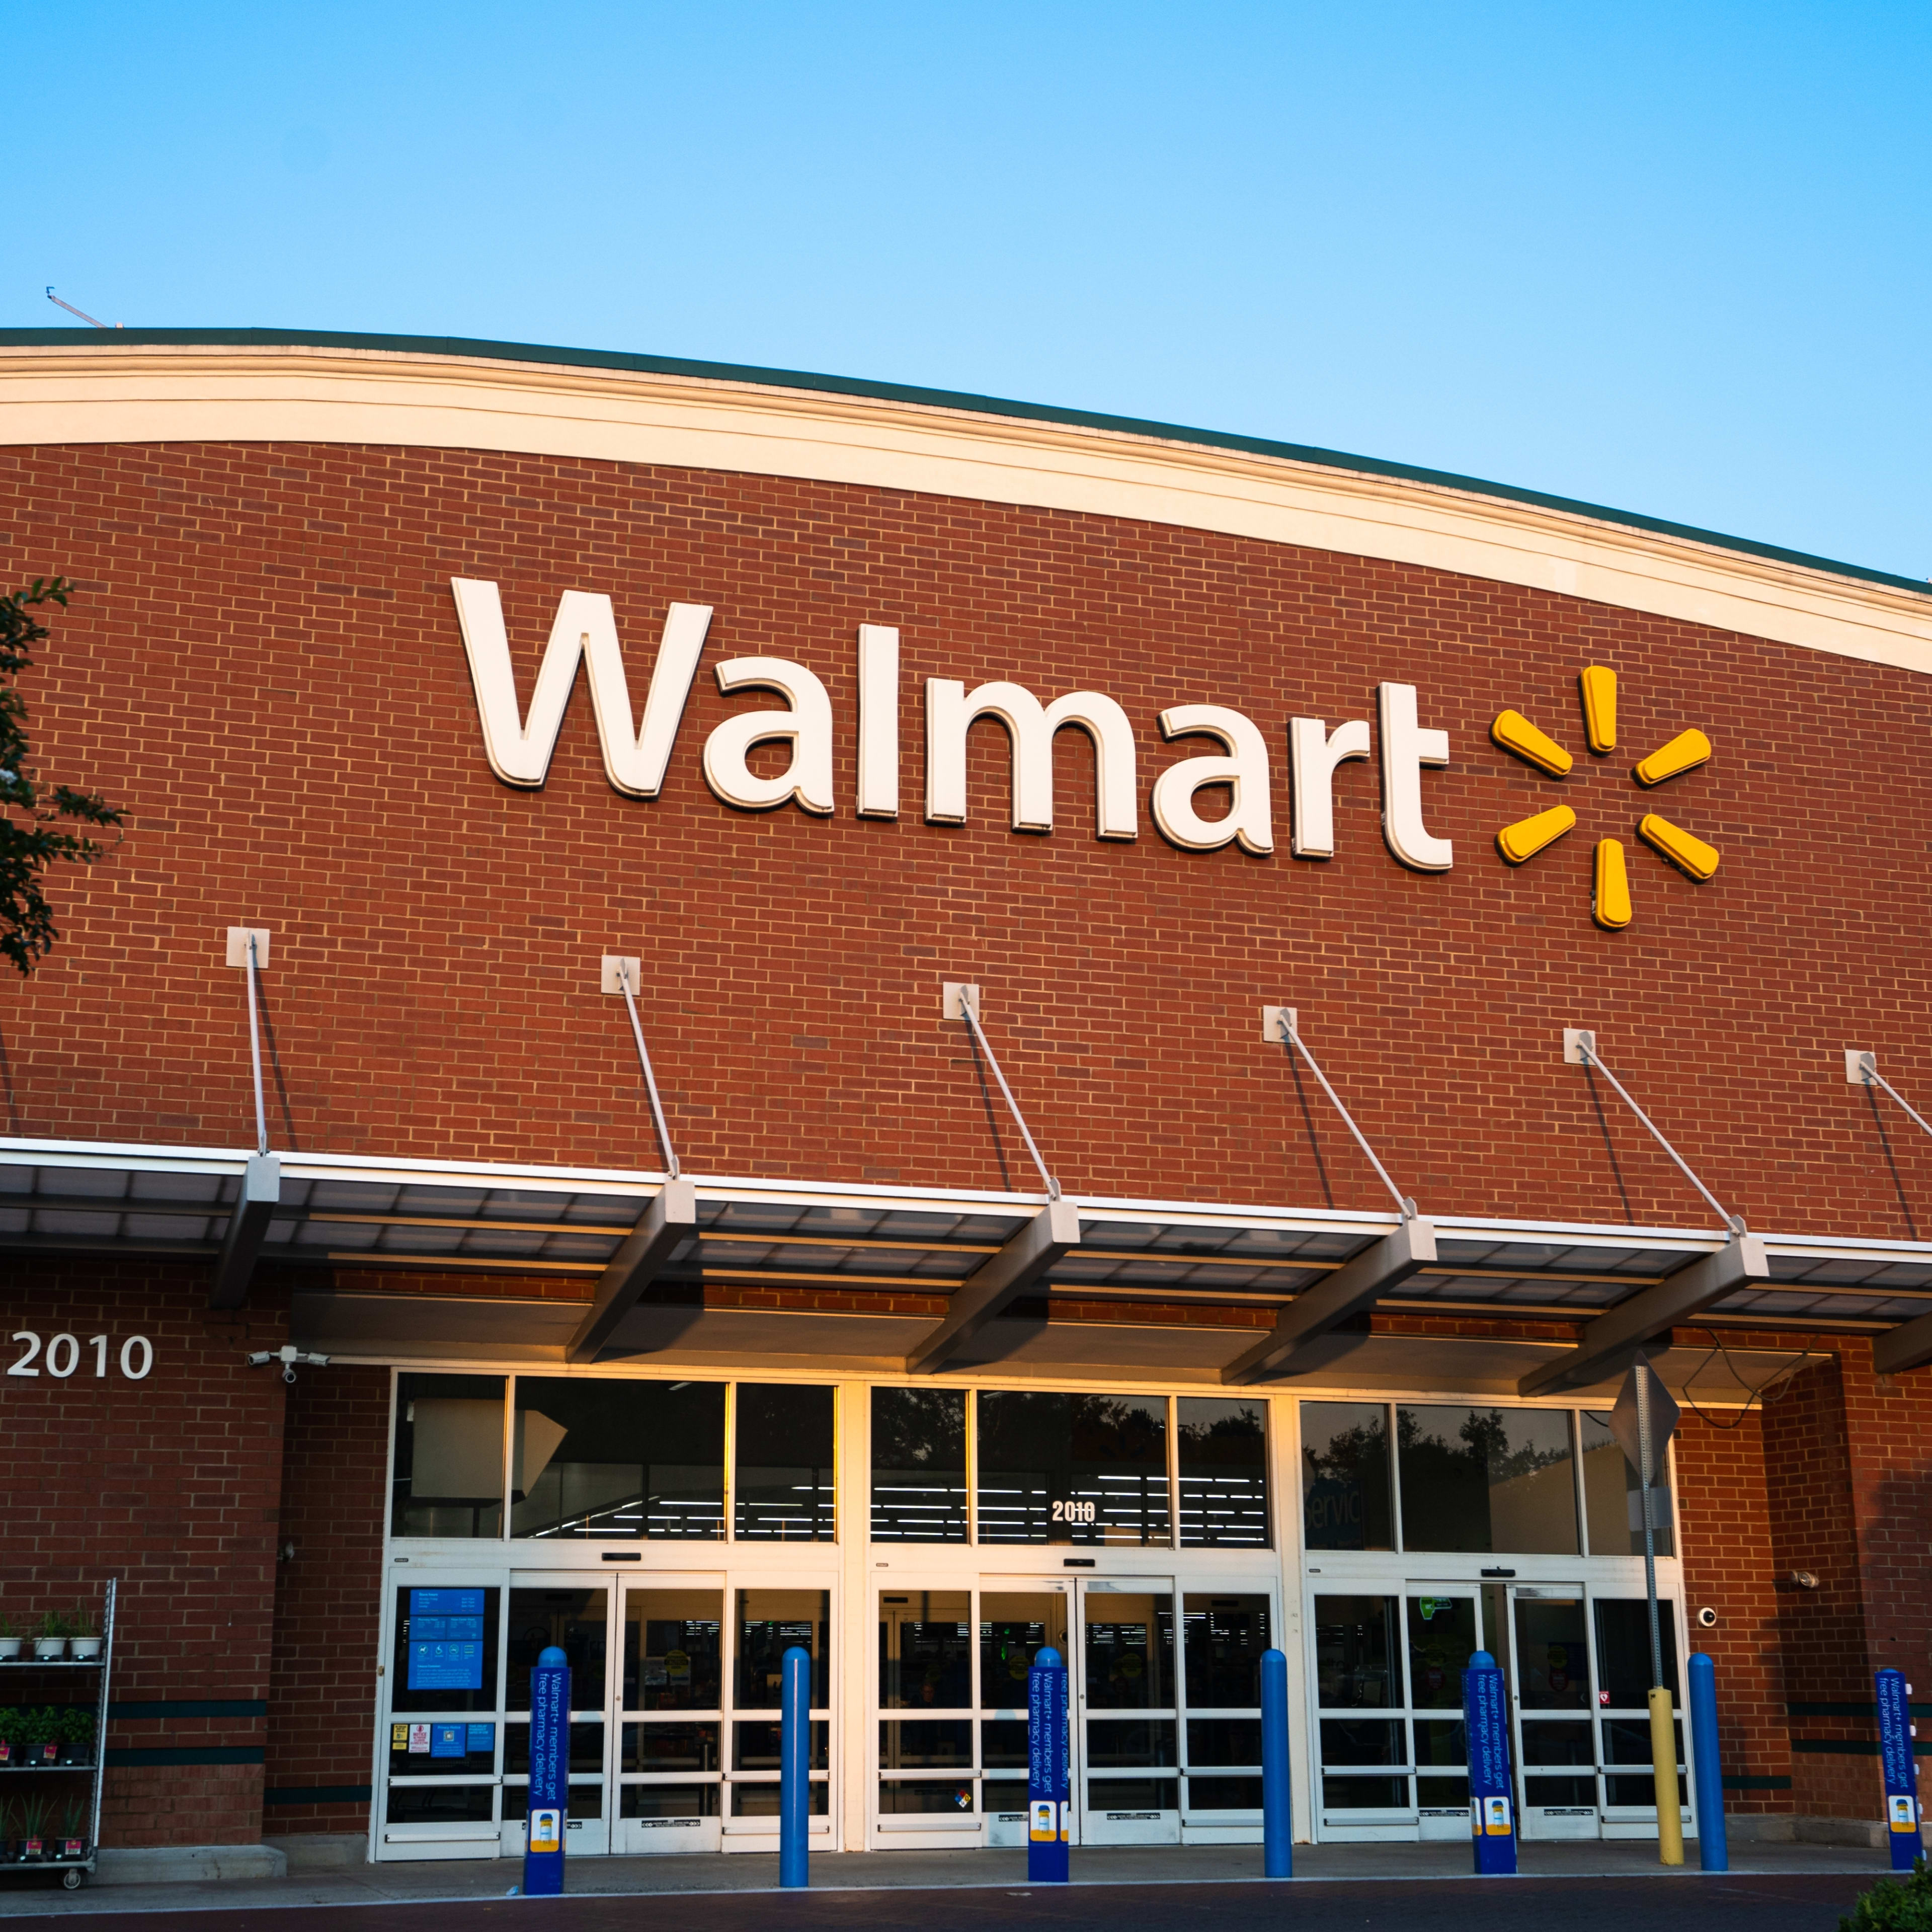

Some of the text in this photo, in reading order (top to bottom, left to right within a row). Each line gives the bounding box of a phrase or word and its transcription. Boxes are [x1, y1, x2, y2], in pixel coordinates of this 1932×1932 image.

[450, 577, 1455, 871] Walmart
[7, 1331, 153, 1380] 2010
[1052, 1501, 1095, 1522] 2010
[533, 1673, 549, 1796] free pharmacy delivery
[546, 1673, 561, 1801] Walmart+ members get
[1030, 1672, 1041, 1788] free pharmacy delivery
[1042, 1672, 1054, 1793] Walmart+ members get
[1477, 1674, 1492, 1785] free pharmacy delivery
[1489, 1674, 1504, 1789] Walmart+ members get
[1879, 1678, 1896, 1784] free pharmacy delivery
[1891, 1677, 1908, 1788] Walmart+ members get
